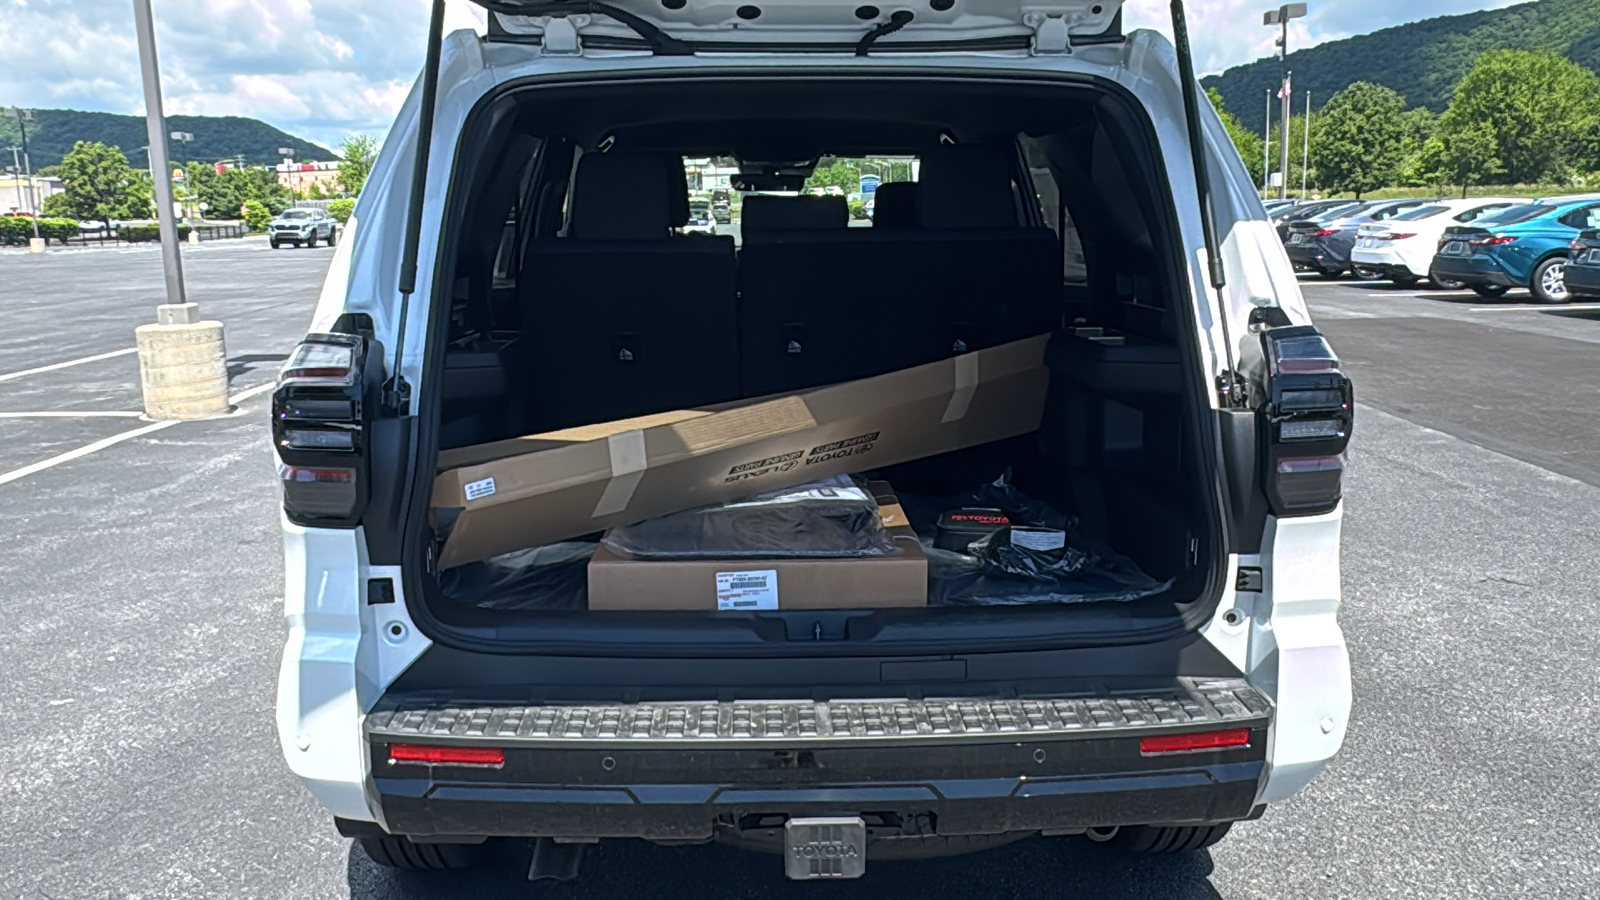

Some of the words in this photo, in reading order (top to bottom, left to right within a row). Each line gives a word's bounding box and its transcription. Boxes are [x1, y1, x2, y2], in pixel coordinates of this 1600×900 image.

[843, 433, 877, 447] GENUINE
[813, 441, 841, 454] PARTS
[766, 451, 801, 465] GENUINE
[806, 449, 854, 465] TOYOTA
[734, 460, 762, 473] PARTS
[724, 467, 779, 482] LEXUS
[968, 515, 1010, 523] TOYOTA
[792, 844, 858, 858] TOYOTA
